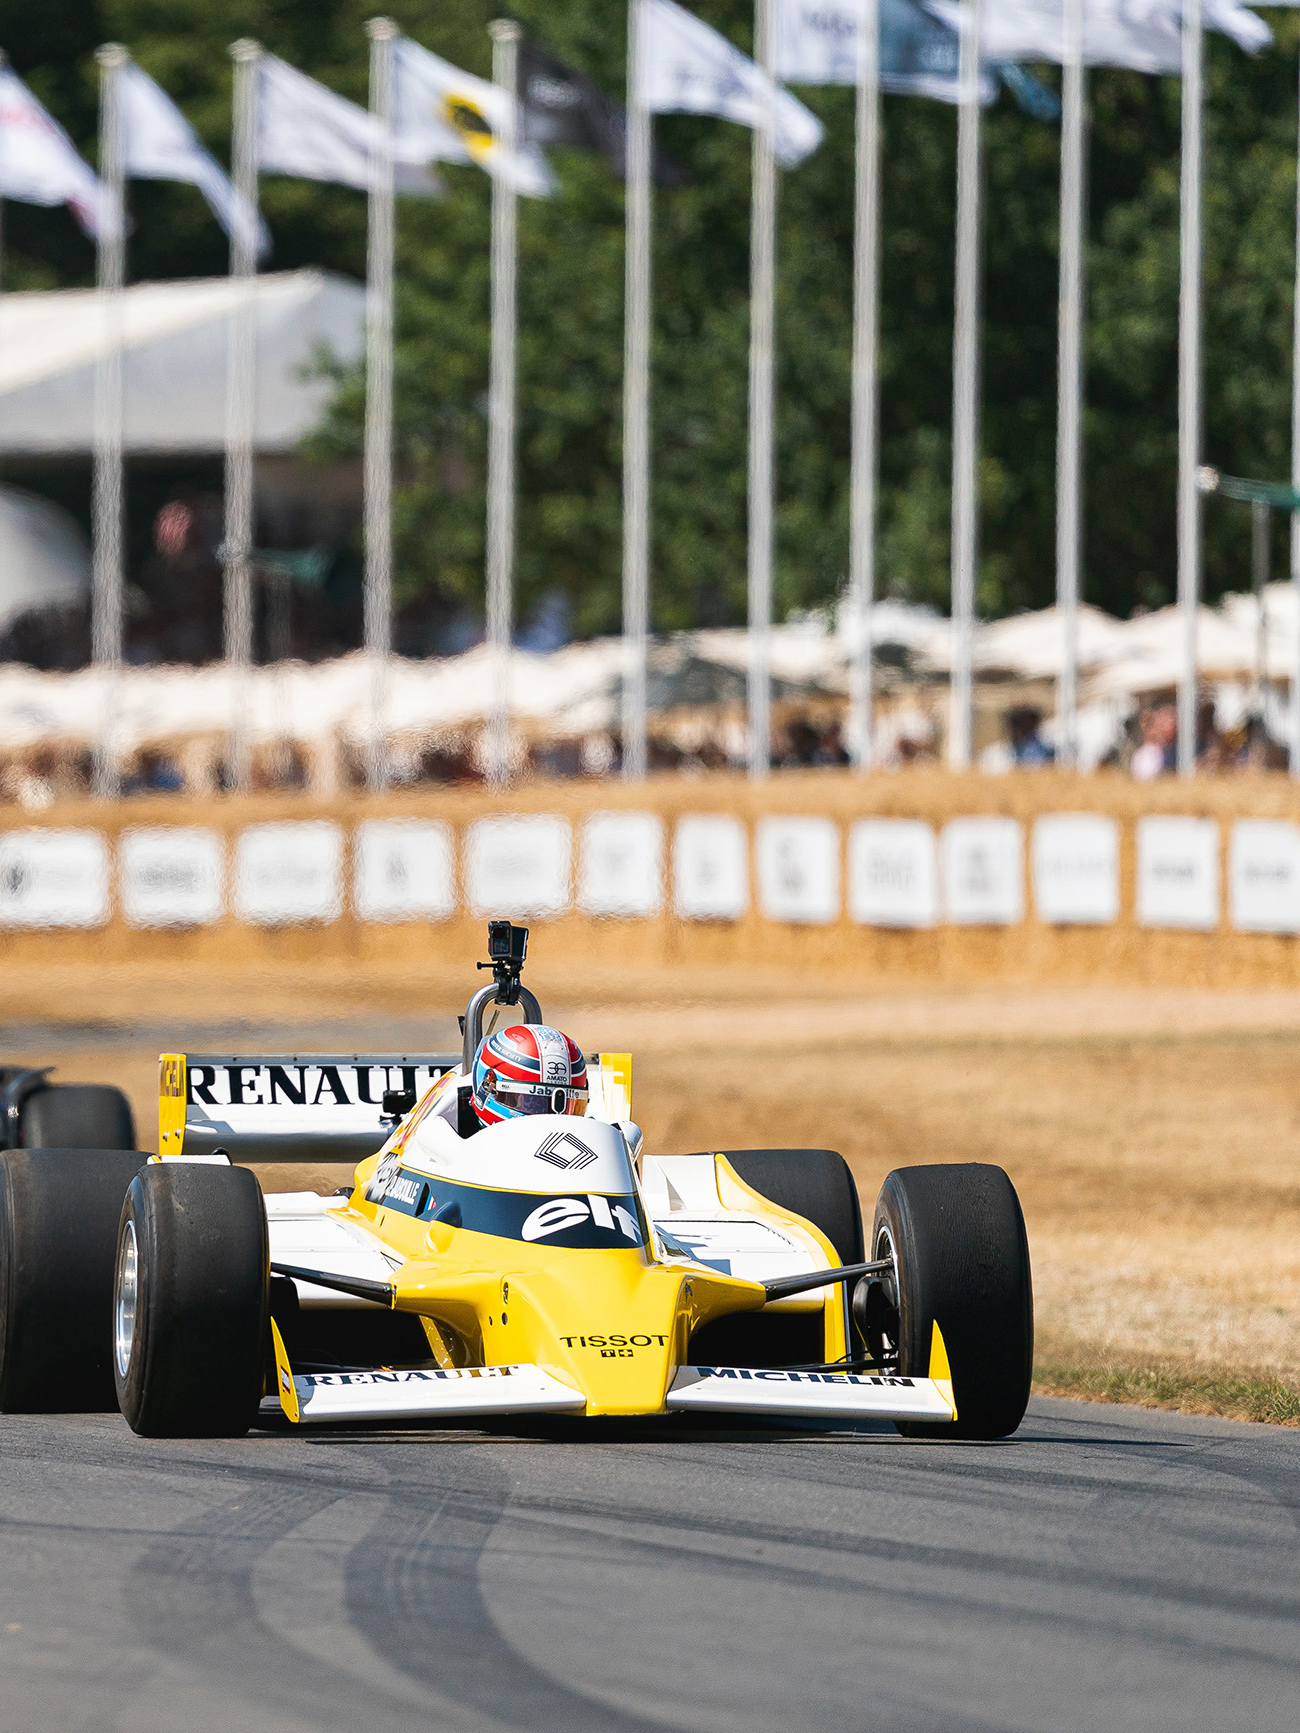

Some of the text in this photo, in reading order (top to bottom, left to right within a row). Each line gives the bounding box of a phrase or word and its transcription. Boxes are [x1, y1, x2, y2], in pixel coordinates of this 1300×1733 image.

[529, 1085, 580, 1099] Jabille
[559, 1334, 670, 1348] TISSOT
[303, 1366, 519, 1387] RENAULT
[697, 1366, 916, 1388] MICHELIN
